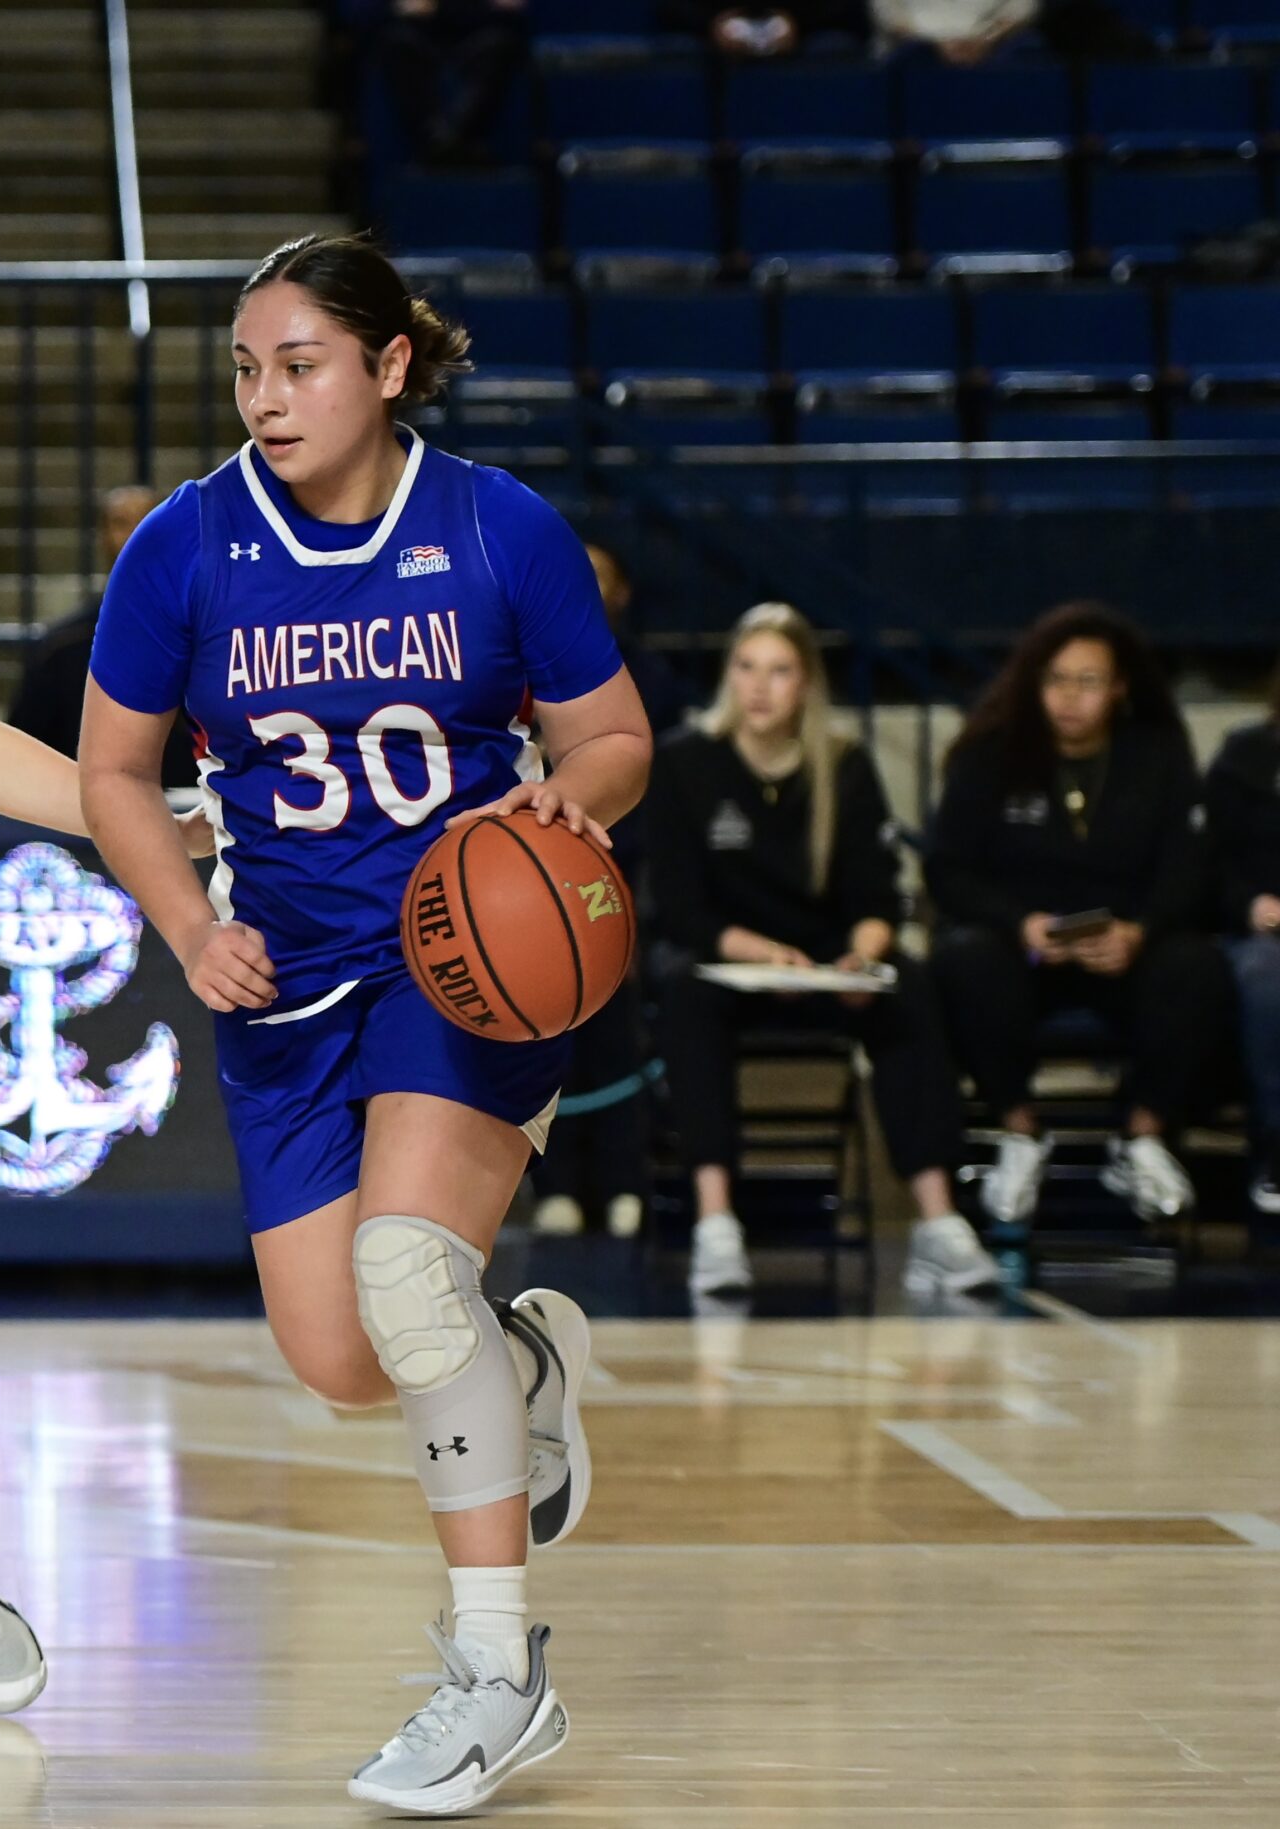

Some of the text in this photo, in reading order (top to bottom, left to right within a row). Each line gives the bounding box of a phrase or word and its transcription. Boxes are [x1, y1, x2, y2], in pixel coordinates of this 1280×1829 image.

[397, 555, 450, 570] PATRIOT
[398, 562, 451, 578] LEAGUE
[226, 611, 462, 698] AMERICAN
[246, 703, 454, 832] 30
[577, 880, 613, 922] N
[418, 872, 499, 1028] THE ROCK
